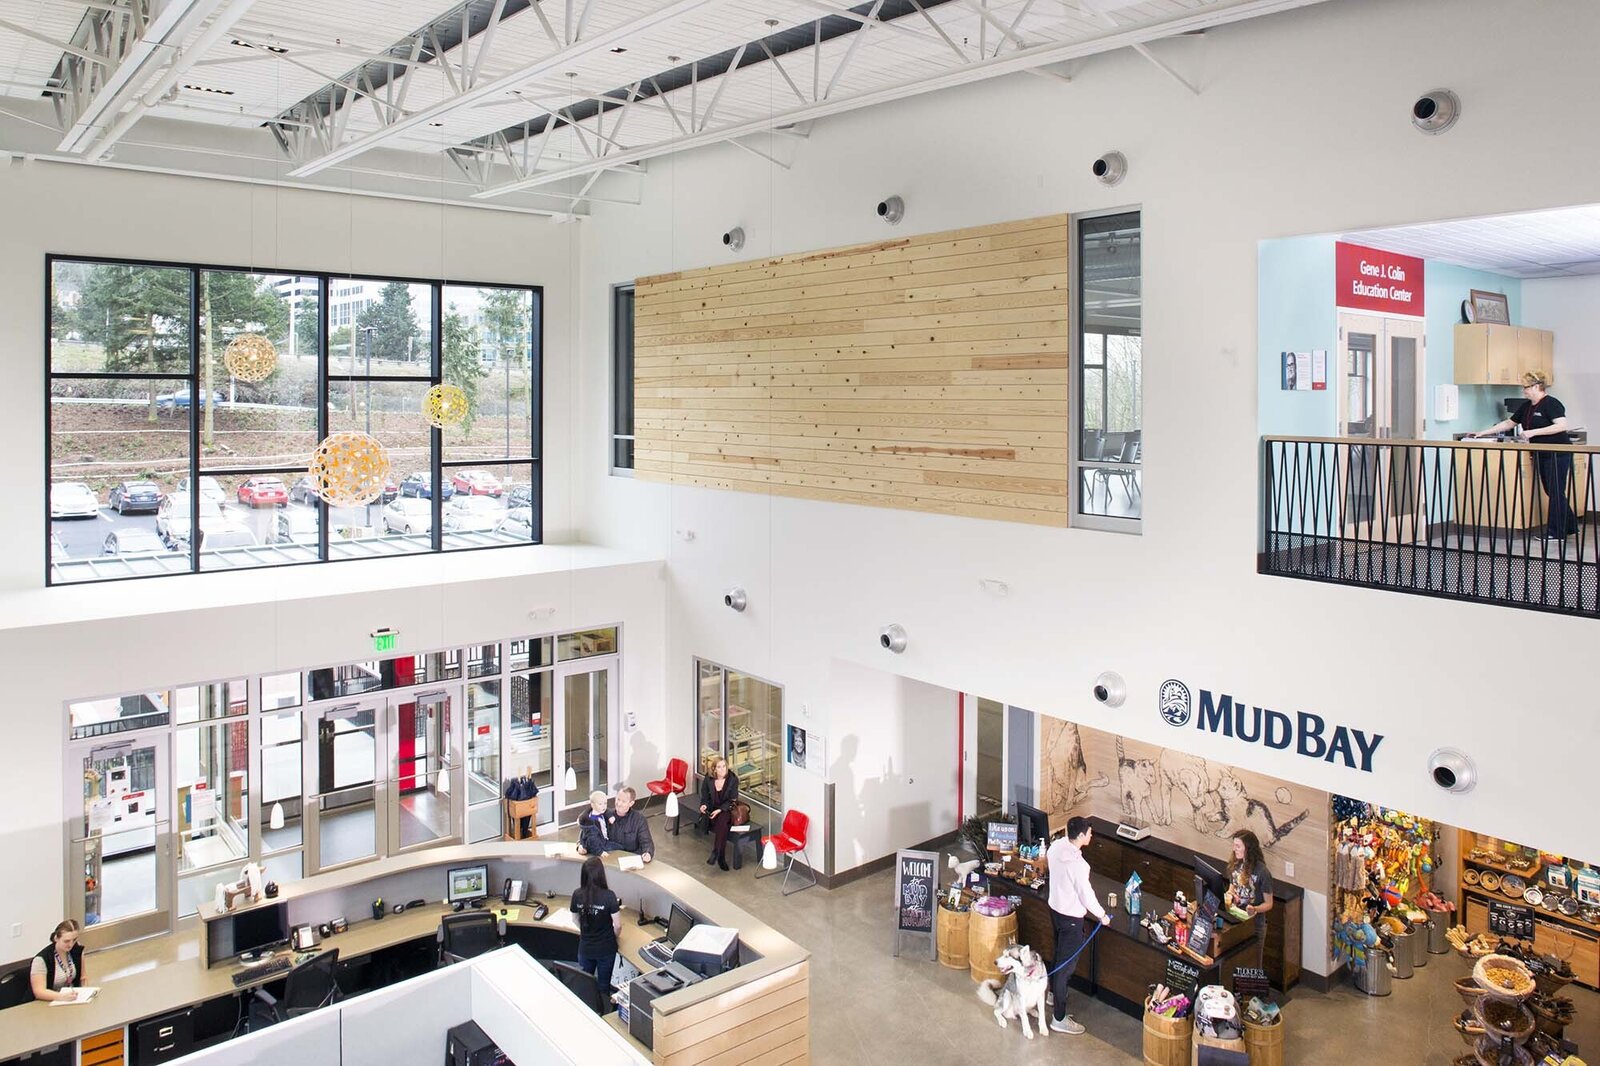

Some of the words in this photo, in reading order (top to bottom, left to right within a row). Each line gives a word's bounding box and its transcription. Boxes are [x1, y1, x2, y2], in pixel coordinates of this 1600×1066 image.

[1360, 260, 1380, 277] Gene
[1380, 264, 1387, 278] J.
[1387, 265, 1405, 282] Colin
[1352, 280, 1389, 299] Education
[1389, 286, 1412, 302] Center
[376, 635, 395, 651] EXIT
[902, 861, 932, 878] WELCOME
[902, 883, 928, 896] MUD
[904, 894, 928, 907] BAY
